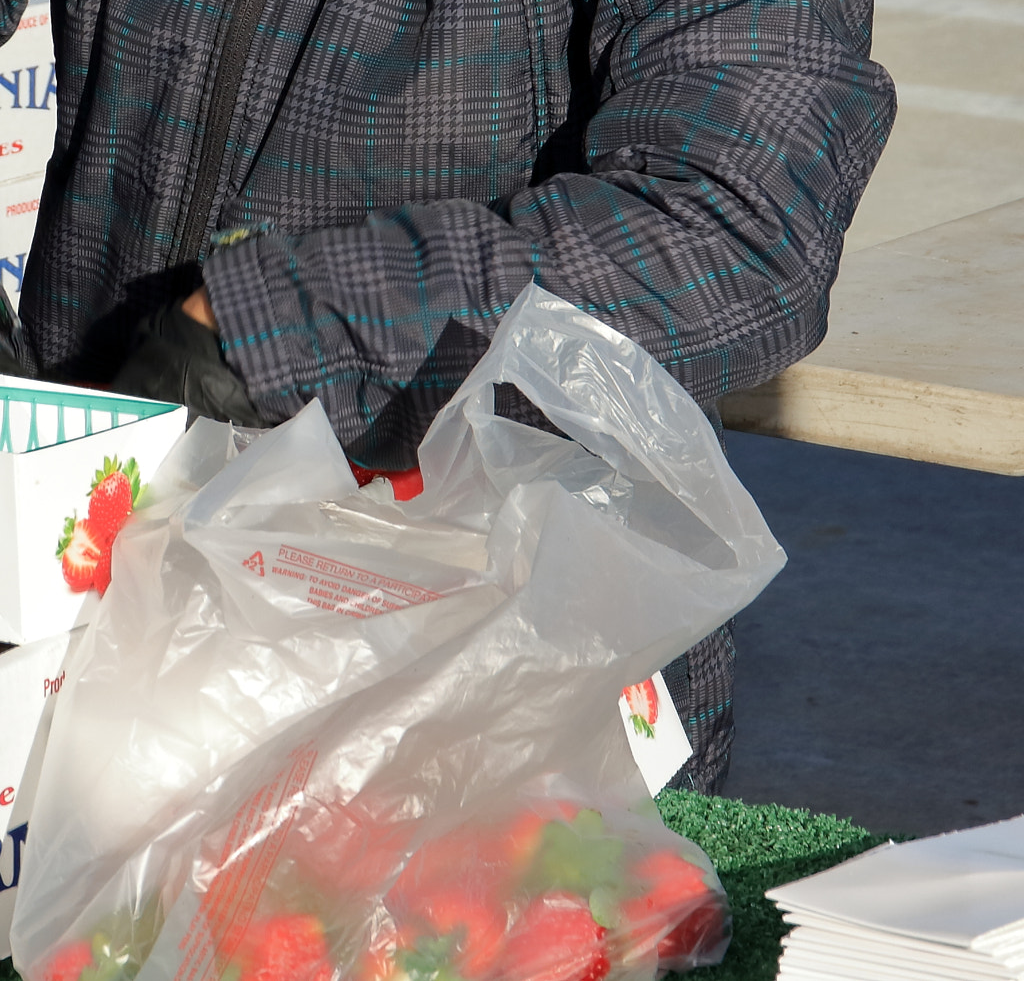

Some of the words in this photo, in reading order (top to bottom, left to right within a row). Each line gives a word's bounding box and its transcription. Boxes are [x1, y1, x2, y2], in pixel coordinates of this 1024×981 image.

[6, 198, 39, 217] PRODUC
[278, 548, 315, 568] PLEASE
[316, 559, 356, 579] RETURN
[356, 571, 370, 582] TO
[370, 576, 378, 585] A
[378, 578, 439, 603] PARTICIPAT
[309, 575, 319, 585] TO
[319, 577, 341, 591] AVOID
[371, 594, 383, 604] OF
[333, 593, 350, 605] AND
